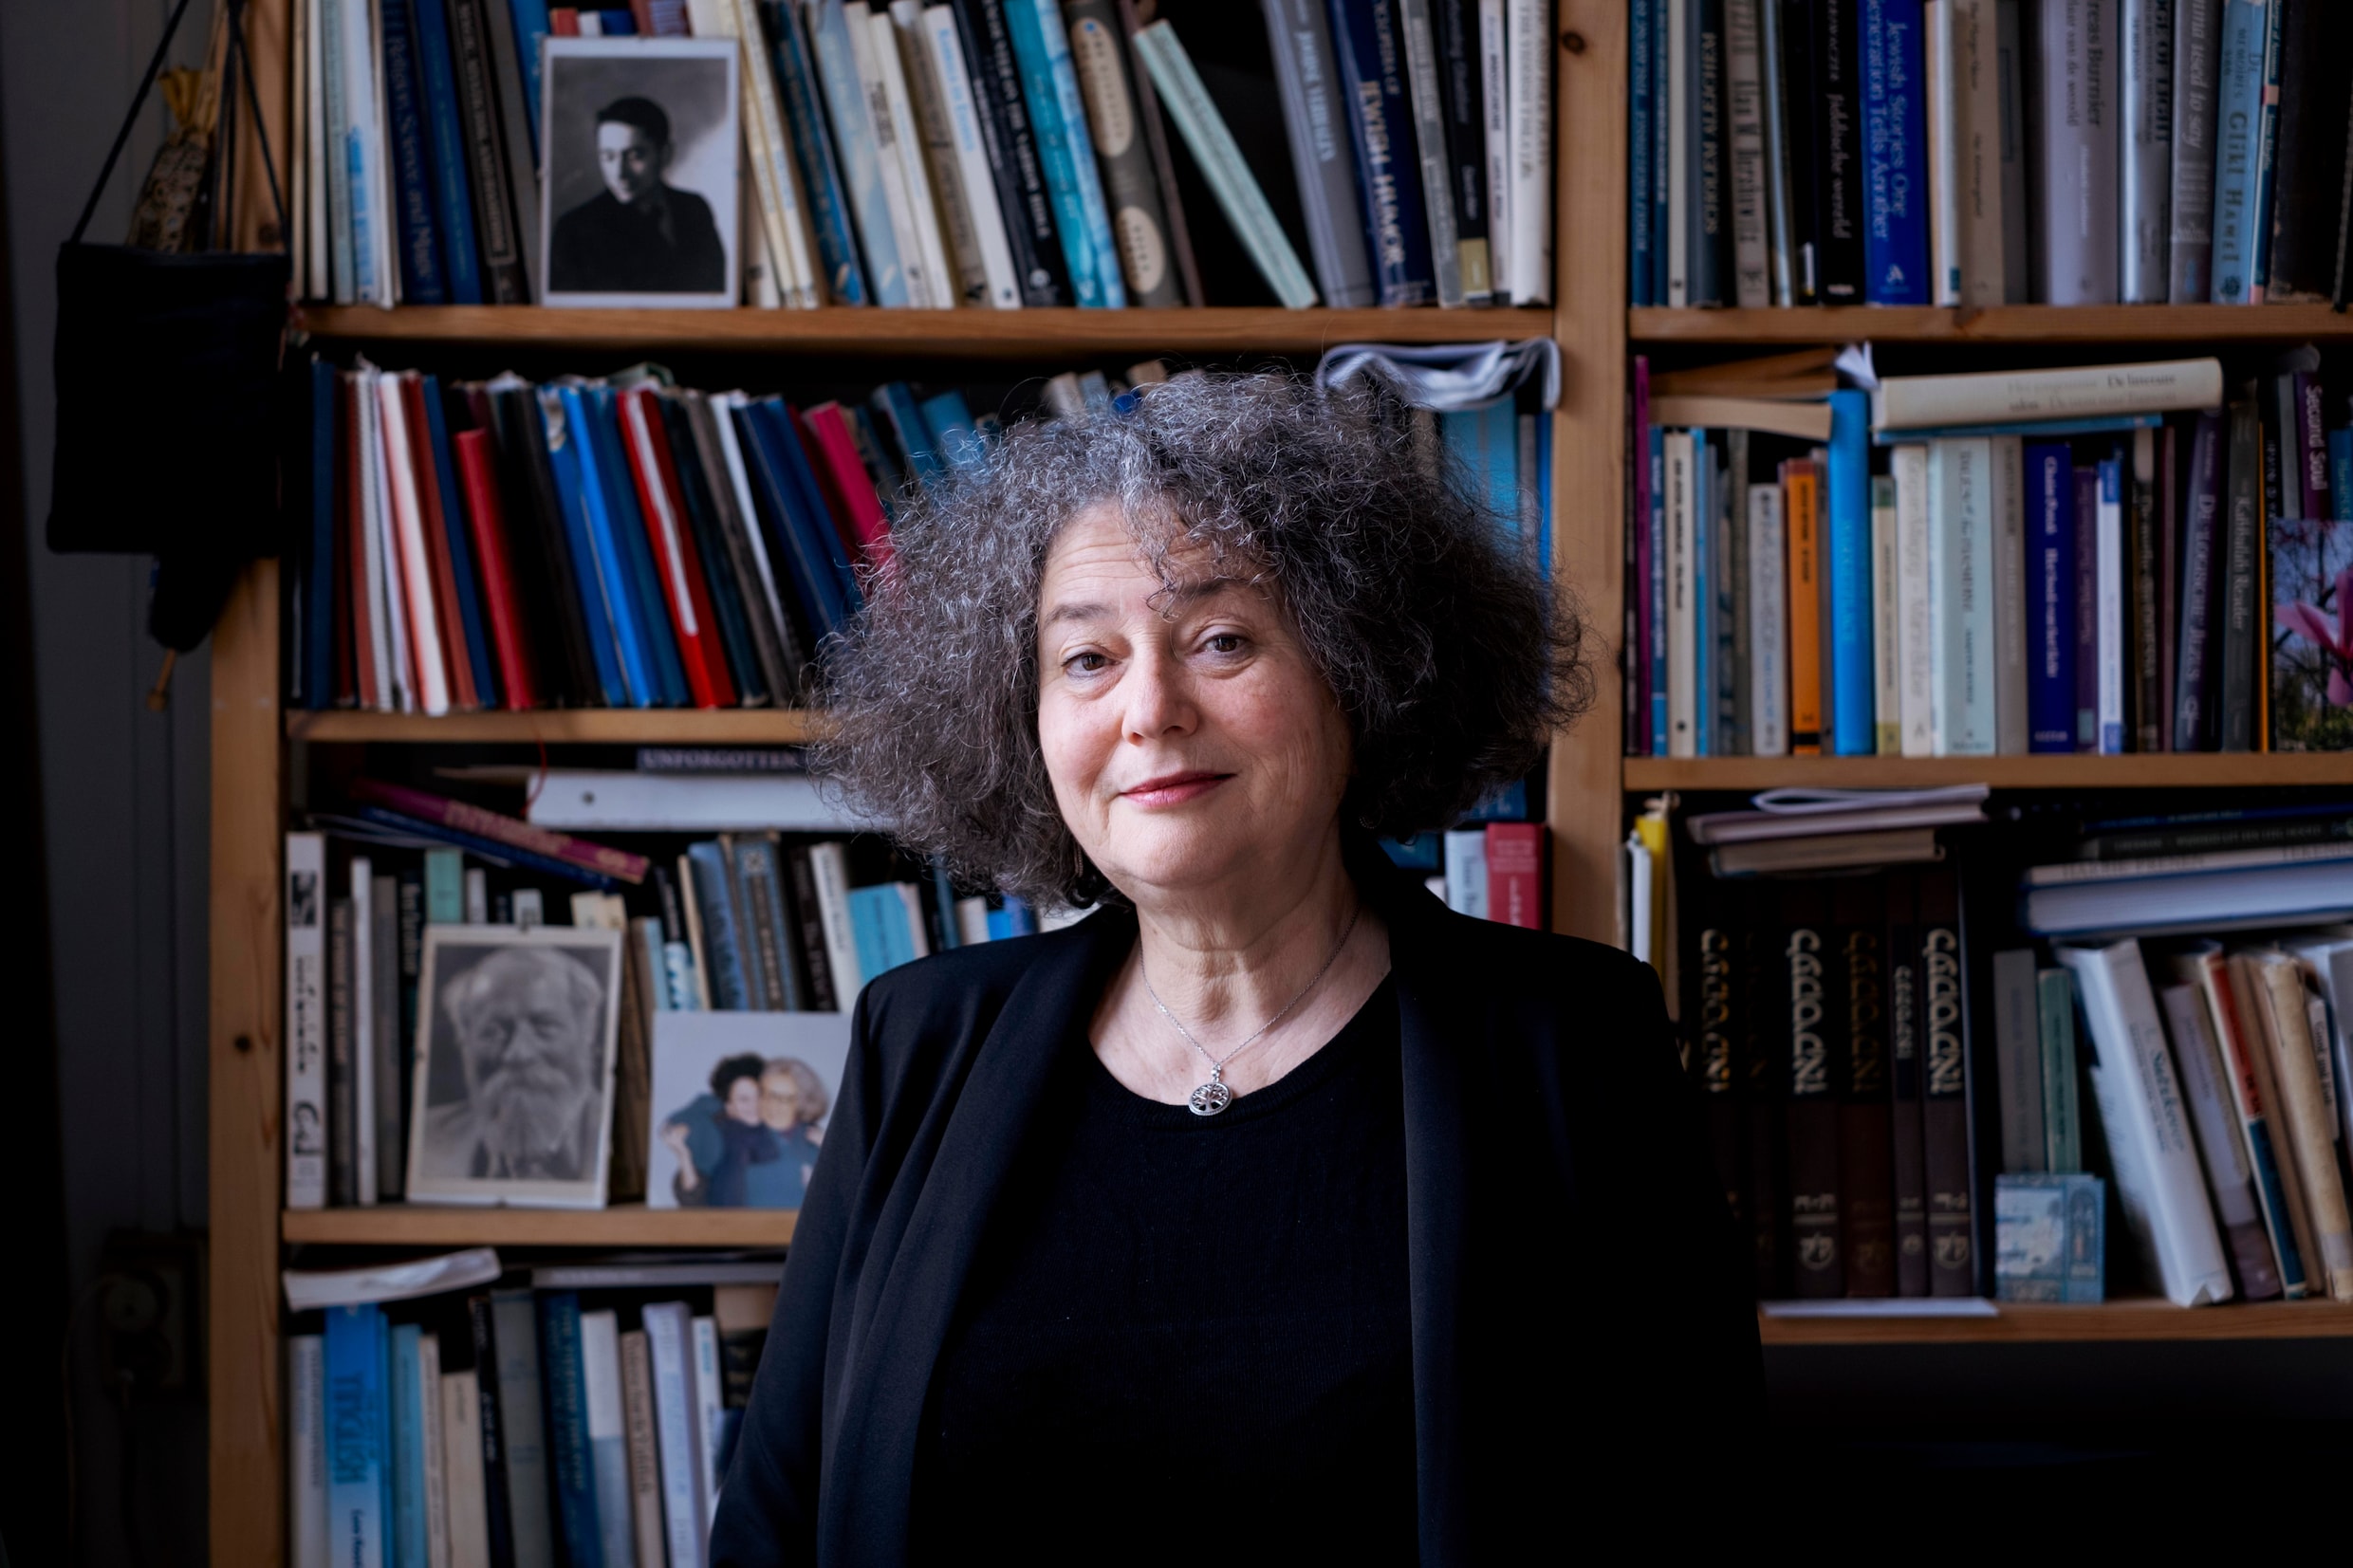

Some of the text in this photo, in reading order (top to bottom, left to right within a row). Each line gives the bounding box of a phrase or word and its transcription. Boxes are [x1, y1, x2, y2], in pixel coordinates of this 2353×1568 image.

[2087, 47, 2105, 127] Burnier
[2189, 44, 2209, 88] used
[2189, 91, 2207, 112] to
[1866, 0, 1890, 241] eneration Tells Another
[1886, 19, 1911, 218] Jewish Stories One
[2181, 114, 2203, 149] say
[1359, 81, 1405, 267] JEWISH HUMOR
[2305, 385, 2329, 490] Second Soul
[2233, 496, 2251, 573] Kabbalah
[2233, 574, 2250, 631] Reader
